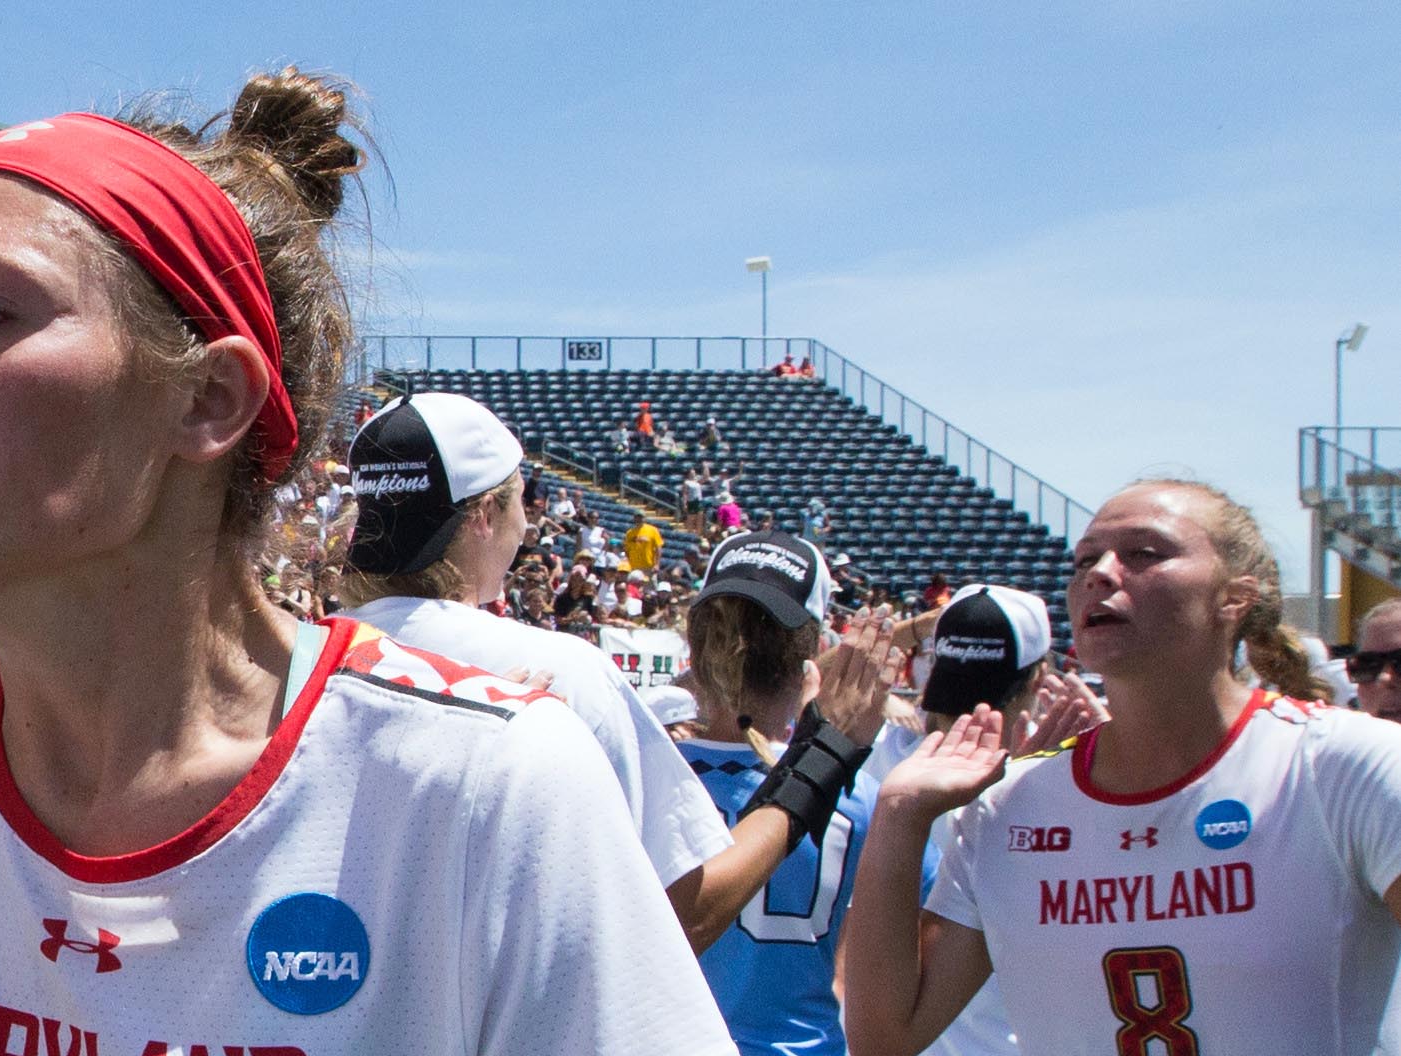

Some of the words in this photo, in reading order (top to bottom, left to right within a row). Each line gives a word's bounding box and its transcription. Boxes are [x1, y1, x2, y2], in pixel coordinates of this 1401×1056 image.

[569, 343, 600, 360] 133
[1038, 861, 1256, 925] MARYLAND
[263, 951, 360, 981] NCAA
